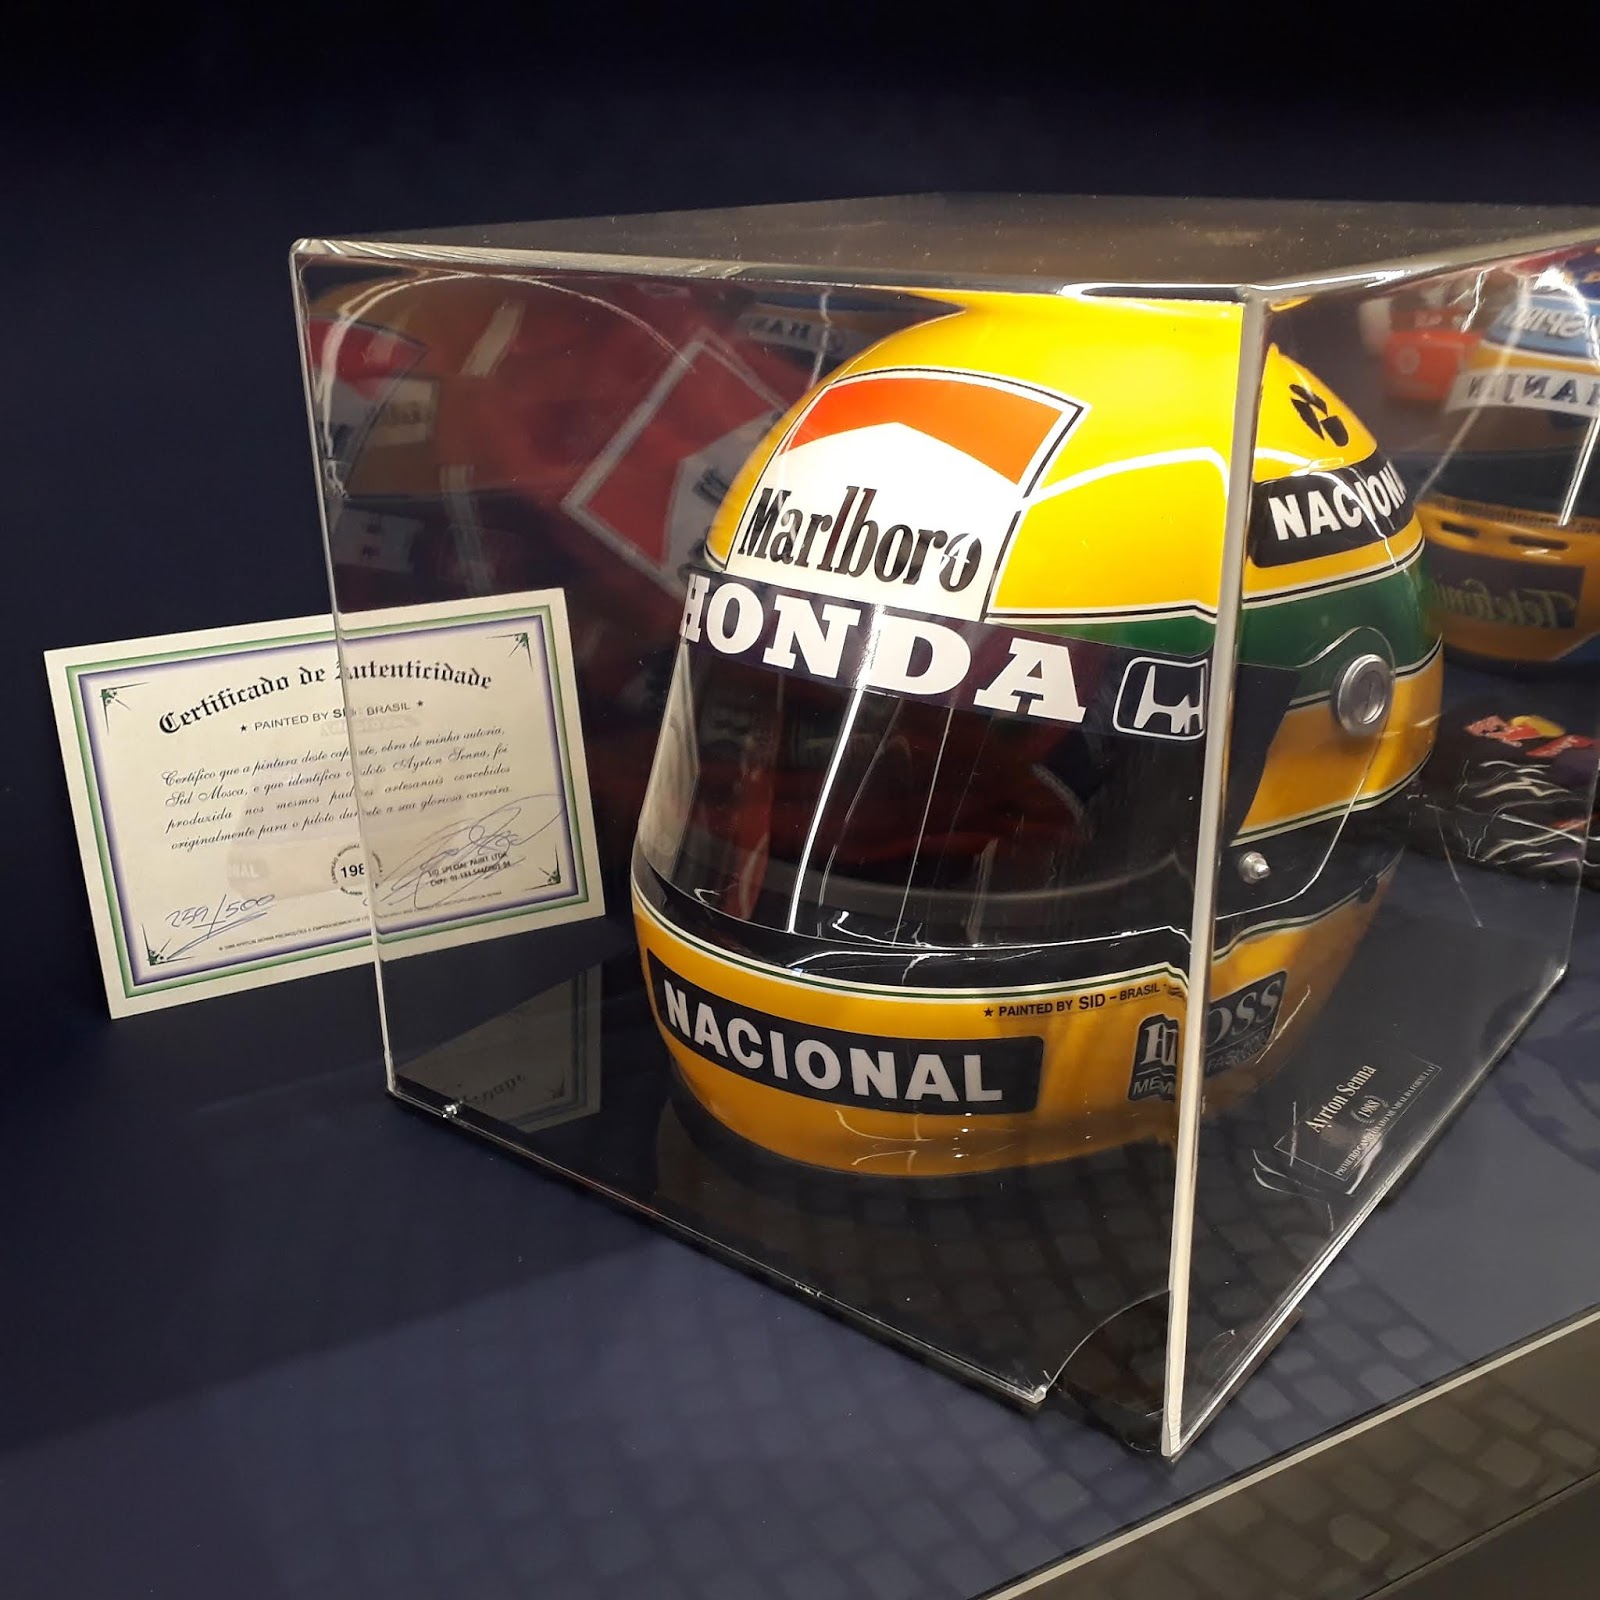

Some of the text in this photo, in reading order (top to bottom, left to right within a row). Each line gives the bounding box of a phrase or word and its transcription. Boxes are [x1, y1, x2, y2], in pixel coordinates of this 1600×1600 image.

[737, 485, 983, 593] Marlboro
[679, 573, 1087, 724] HONDA
[159, 676, 290, 733] Certificado
[299, 666, 326, 685] de
[254, 715, 309, 731] PAINTED
[312, 711, 329, 723] BY
[367, 701, 411, 716] BRASIL
[162, 768, 216, 786] Certifico
[219, 768, 240, 782] que
[252, 758, 298, 775] pintura
[301, 750, 328, 763] deste
[409, 735, 422, 747] de
[425, 731, 460, 746] minha
[165, 791, 193, 808] Sid
[198, 785, 248, 801] Mosca,
[263, 782, 284, 796] que
[288, 769, 341, 788] identifica
[392, 755, 443, 773] Ayrton
[165, 807, 233, 834] produzida
[245, 806, 265, 816] nos
[276, 796, 320, 811] mesmos
[453, 763, 511, 782] concebidos
[171, 827, 255, 852] originalmente
[257, 824, 288, 840] para
[301, 812, 334, 831] piloto
[340, 863, 365, 878] 198
[998, 1003, 1052, 1017] PAINTED
[1056, 1000, 1073, 1012] BY
[1078, 994, 1106, 1010] SID
[1119, 983, 1160, 1000] BRASIL
[663, 978, 1003, 1103] NACIONAL
[1305, 1064, 1377, 1134] Ayrton Senna
